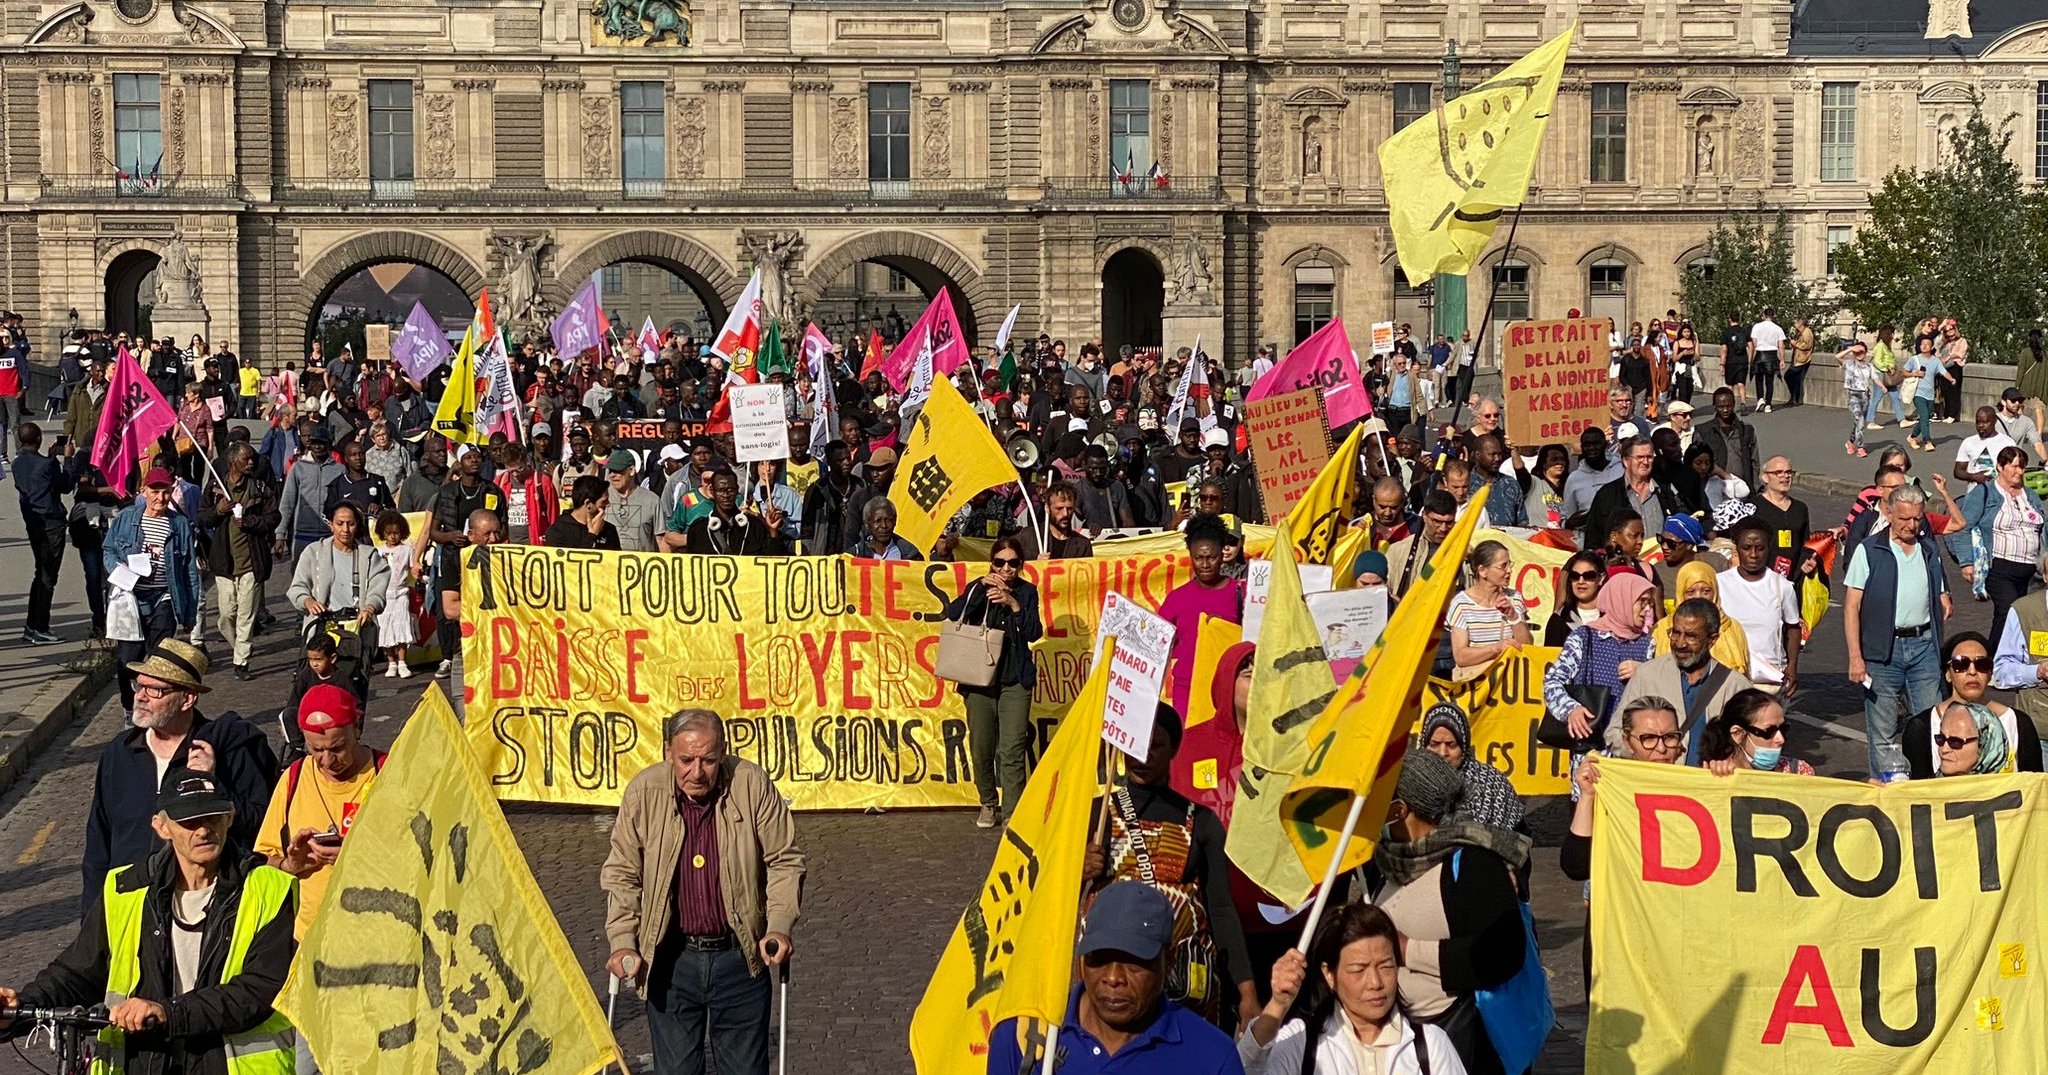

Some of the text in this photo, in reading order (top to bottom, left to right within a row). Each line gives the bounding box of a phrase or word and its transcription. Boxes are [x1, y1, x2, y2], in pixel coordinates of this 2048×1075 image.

[1556, 368, 1608, 387] HONTE
[747, 399, 765, 407] NON
[1247, 405, 1262, 419] AU
[1295, 396, 1309, 408] DE
[735, 419, 785, 429] criminalisation
[1252, 407, 1322, 434] NOUS RENDRE
[1266, 431, 1295, 451] LES
[1261, 467, 1318, 490] TU NOUS
[618, 554, 742, 624] POUR
[676, 675, 726, 702] DES
[734, 629, 945, 711] LOYERS
[1109, 669, 1133, 694] PAIE
[1107, 694, 1126, 717] TES
[491, 706, 638, 790] STOP
[1129, 827, 1147, 852] NOT
[1634, 789, 2023, 900] DROIT
[1760, 944, 1938, 1049] AU
